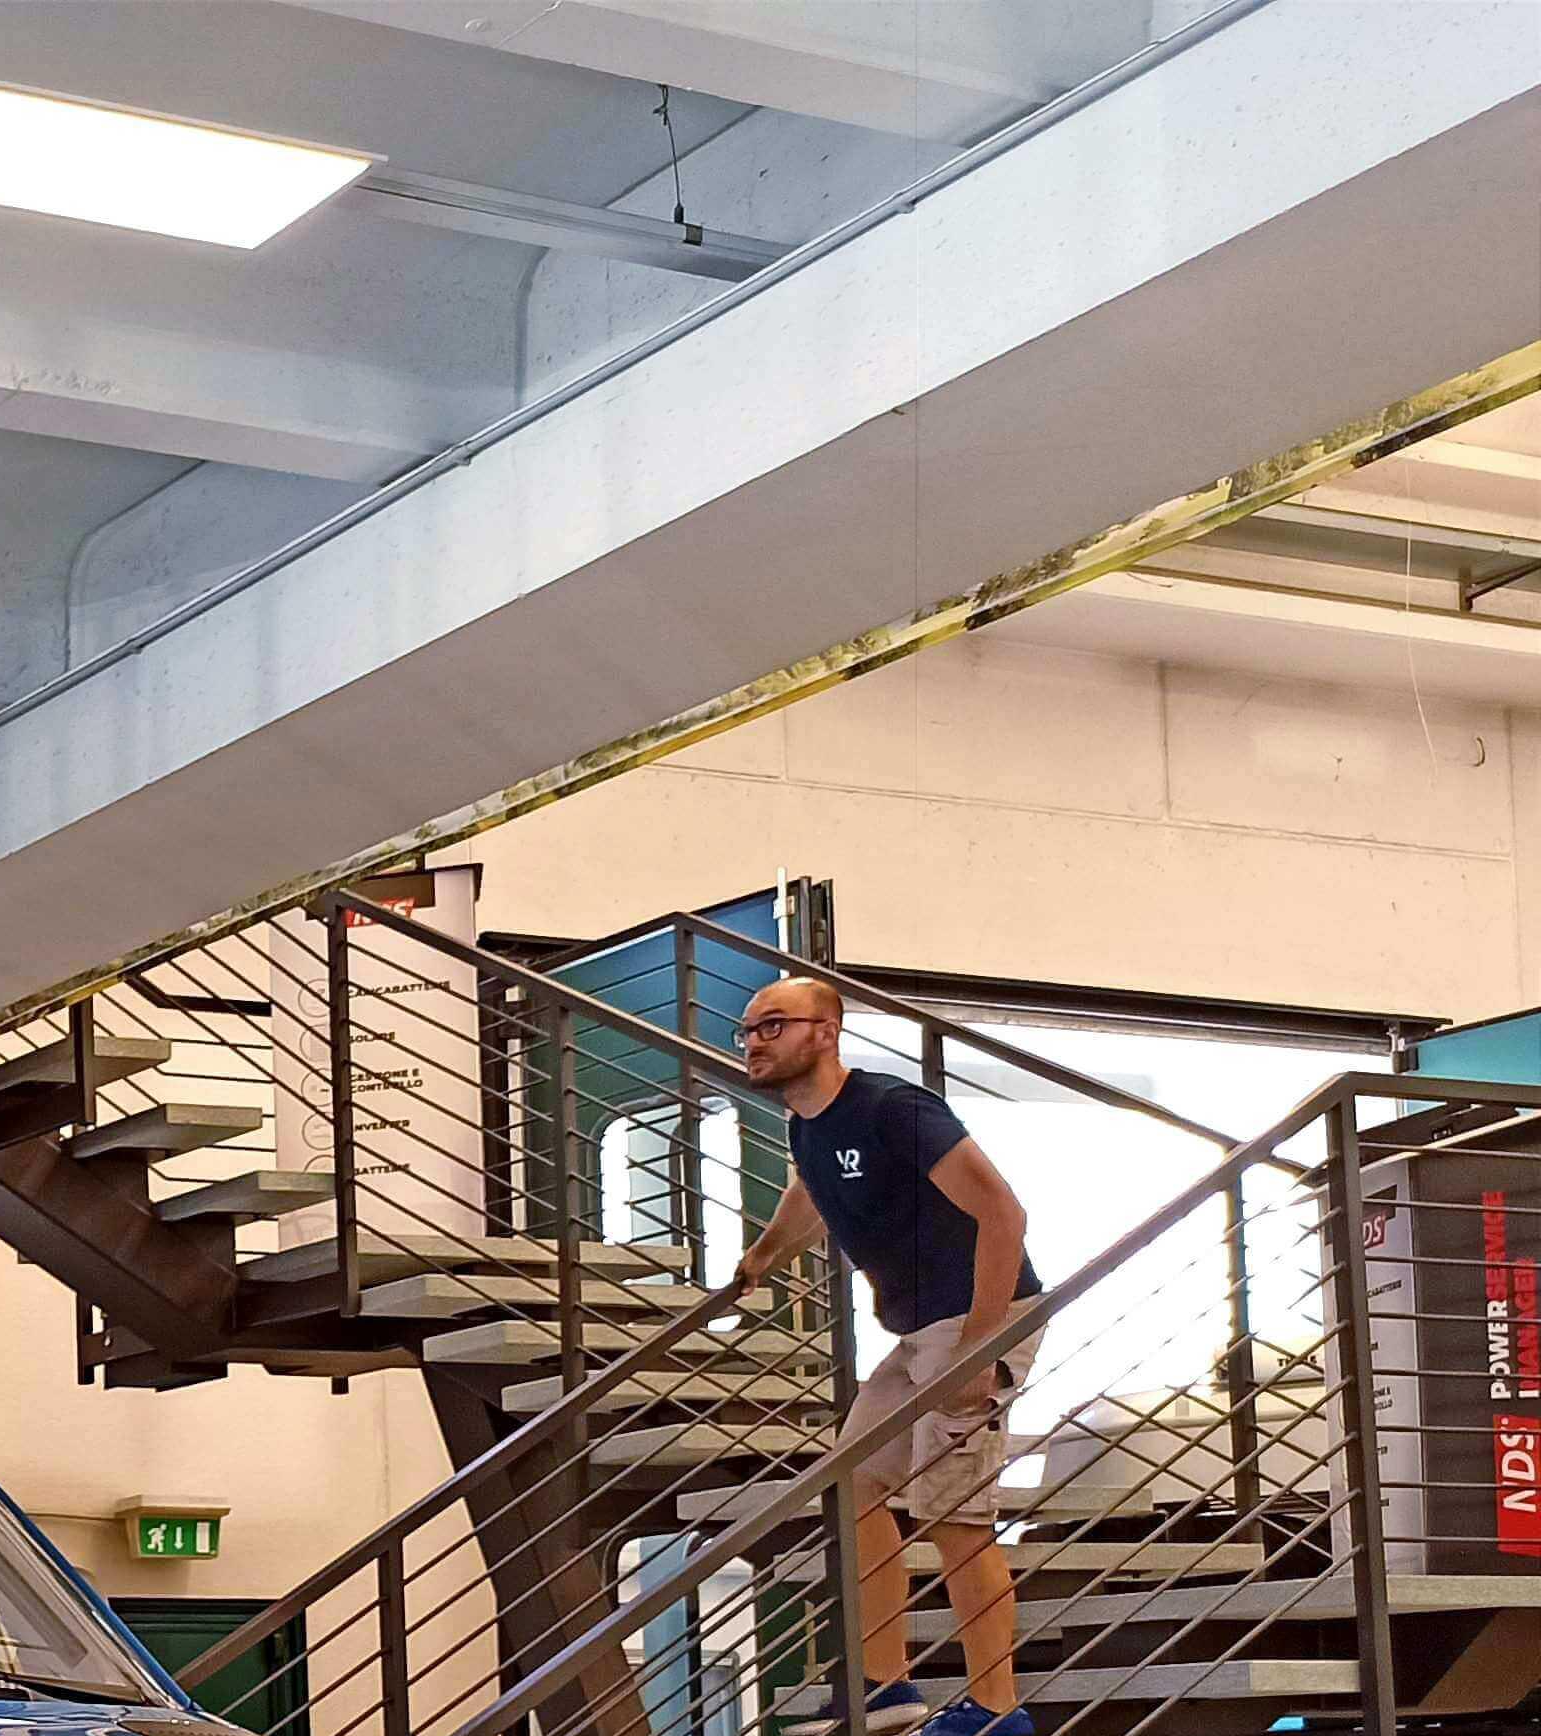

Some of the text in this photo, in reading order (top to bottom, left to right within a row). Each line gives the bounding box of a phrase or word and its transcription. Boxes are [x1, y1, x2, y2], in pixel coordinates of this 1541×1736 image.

[350, 1079, 423, 1094] CONTRLO
[835, 1148, 860, 1171] VR
[1362, 1215, 1385, 1245] DS
